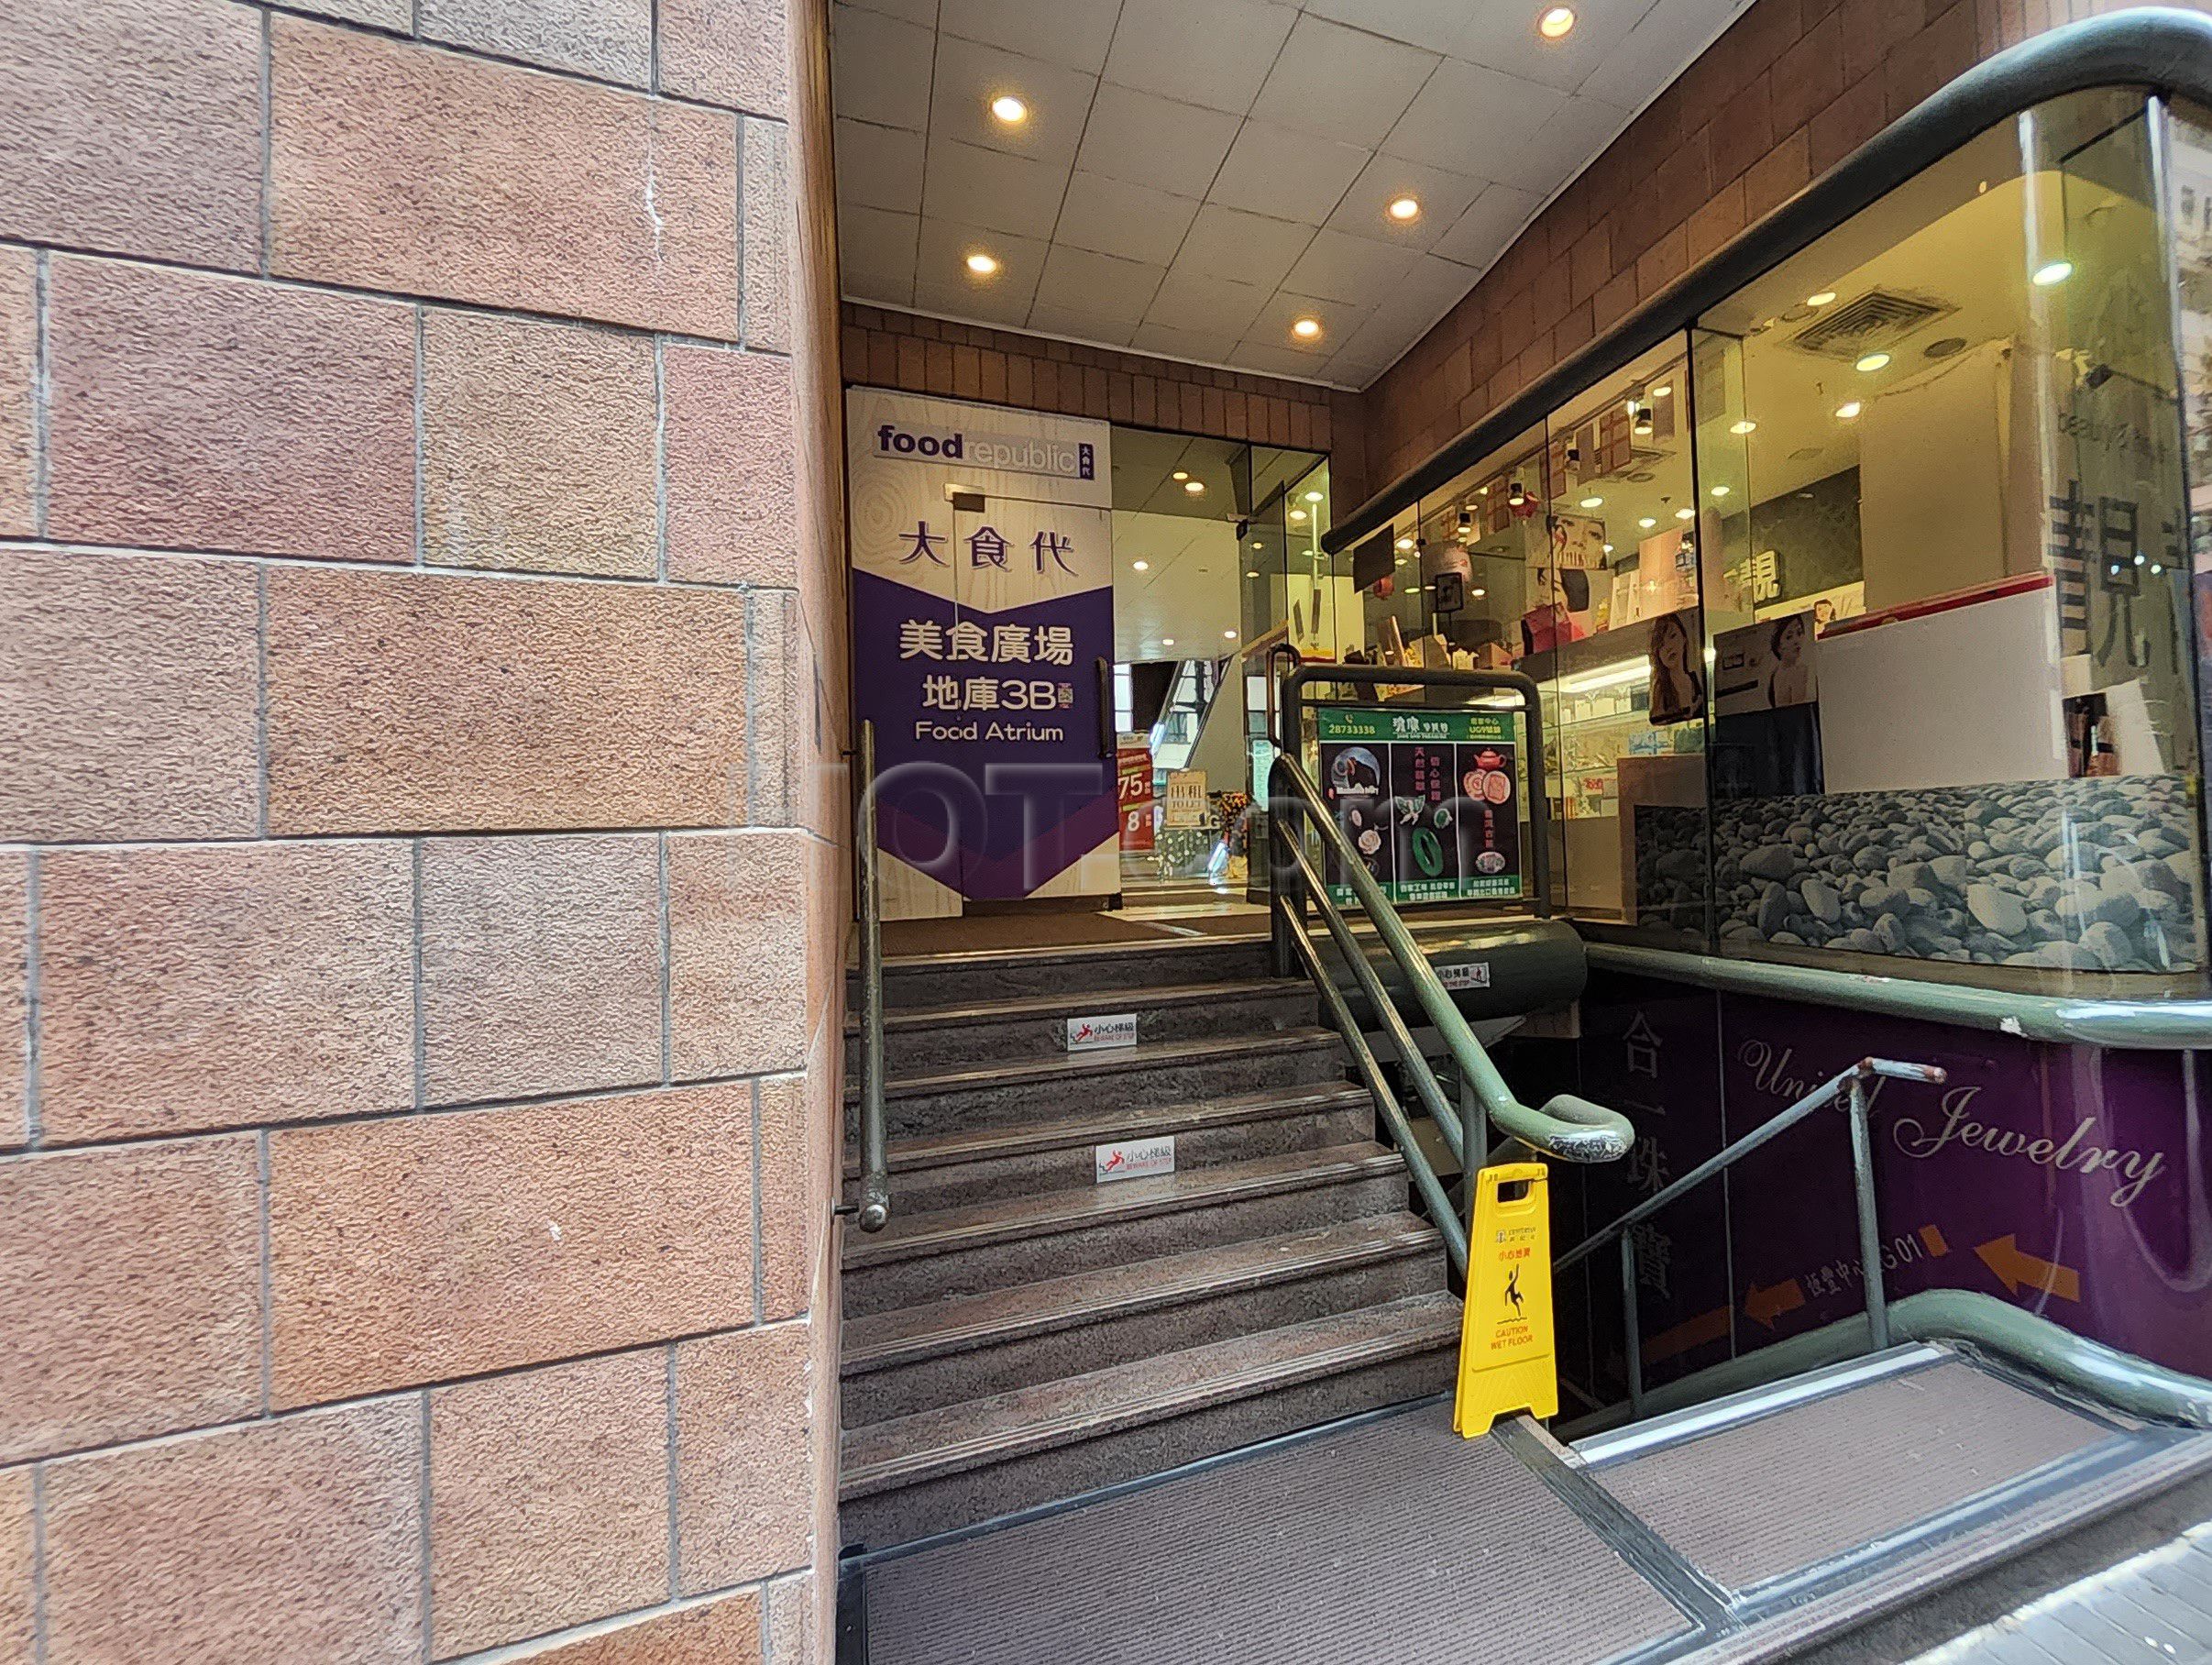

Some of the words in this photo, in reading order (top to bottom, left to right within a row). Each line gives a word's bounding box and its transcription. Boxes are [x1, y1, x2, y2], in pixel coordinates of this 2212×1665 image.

[898, 520, 1079, 578] 大食代
[899, 619, 1074, 667] 美食廣場
[922, 675, 1057, 712] 地庫3B
[915, 721, 978, 742] Food
[985, 721, 1064, 743] Atrium
[1117, 773, 1143, 799] 75
[1128, 810, 1140, 832] 8
[1735, 1039, 1887, 1119] Unied
[1893, 1086, 2167, 1208] Jewelry
[1880, 1234, 1923, 1271] G01
[1491, 1340, 1506, 1350] WET
[1508, 1334, 1533, 1347] FLOOR
[1495, 1326, 1528, 1339] CAUTION
